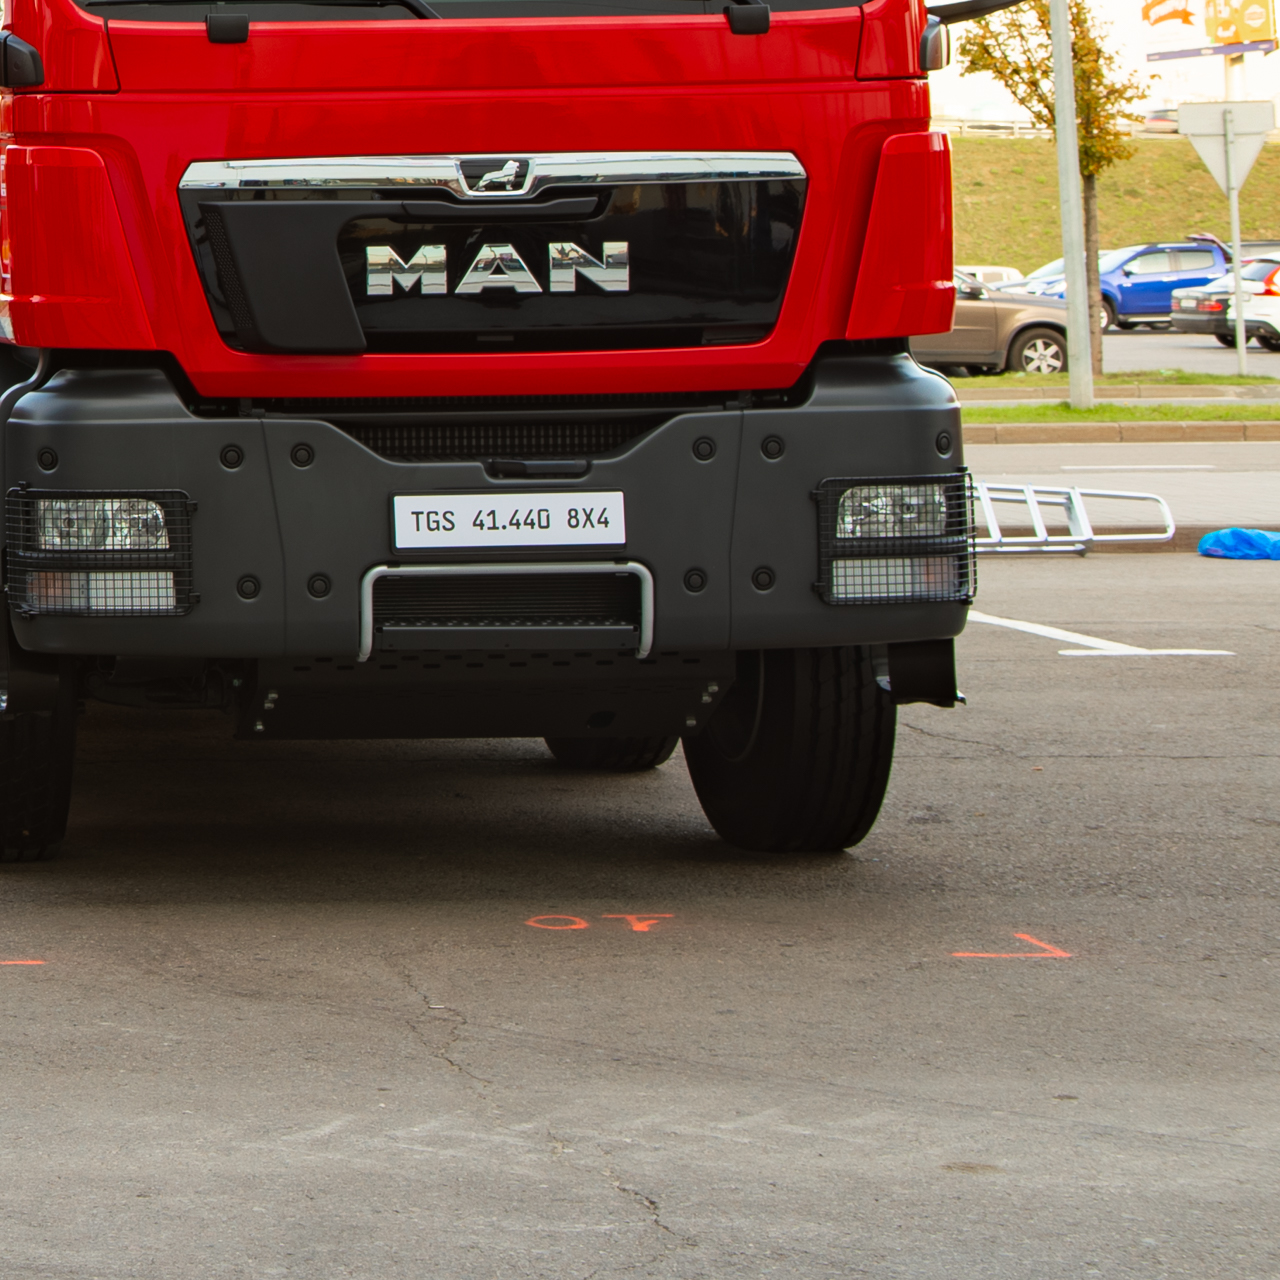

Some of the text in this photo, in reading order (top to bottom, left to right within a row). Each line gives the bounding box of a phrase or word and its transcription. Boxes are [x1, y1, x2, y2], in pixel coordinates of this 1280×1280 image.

[365, 241, 630, 296] MAN
[411, 507, 610, 533] TGS 41.440 8X4
